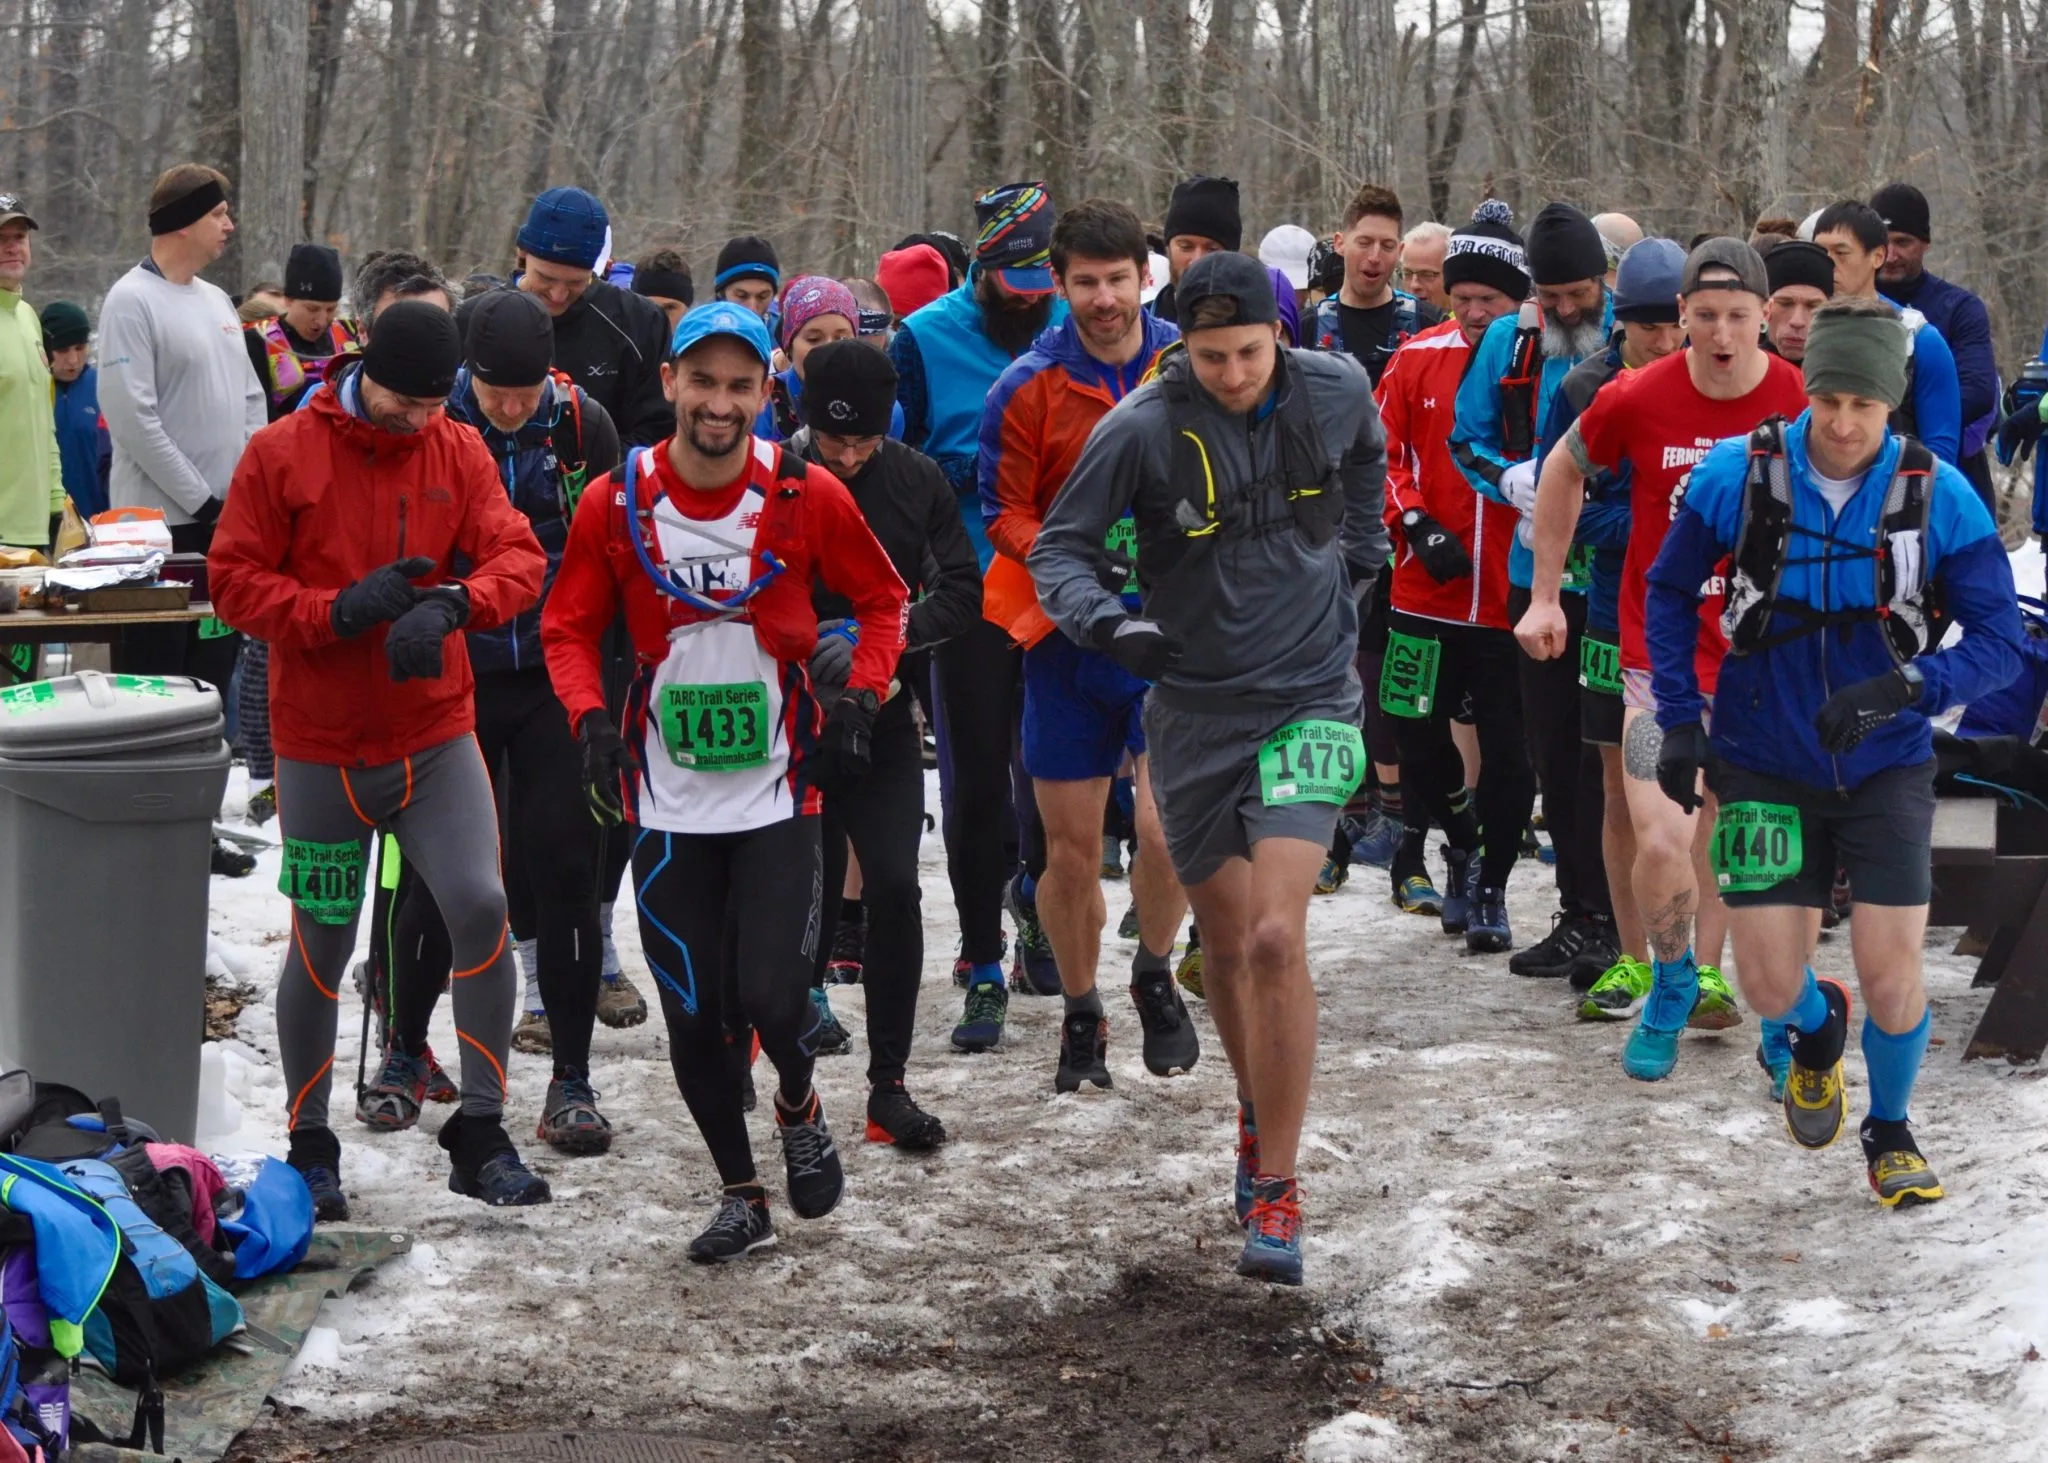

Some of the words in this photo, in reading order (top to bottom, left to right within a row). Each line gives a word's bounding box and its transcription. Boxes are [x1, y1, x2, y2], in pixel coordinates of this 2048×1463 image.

[1389, 644, 1422, 707] 1482
[669, 690, 696, 707] TARC
[698, 689, 722, 706] Trail
[726, 688, 760, 705] Series
[676, 706, 756, 749] 1433
[1296, 726, 1322, 740] Trail
[1325, 727, 1357, 744] Series
[696, 750, 763, 765] trailanimals.com
[1274, 742, 1355, 782] 1479
[1735, 808, 1757, 824] Trail
[1761, 809, 1793, 826] Series
[309, 847, 333, 864] Trail
[335, 846, 361, 864] Serie
[1719, 826, 1788, 868] 1440
[289, 863, 360, 902] 1408
